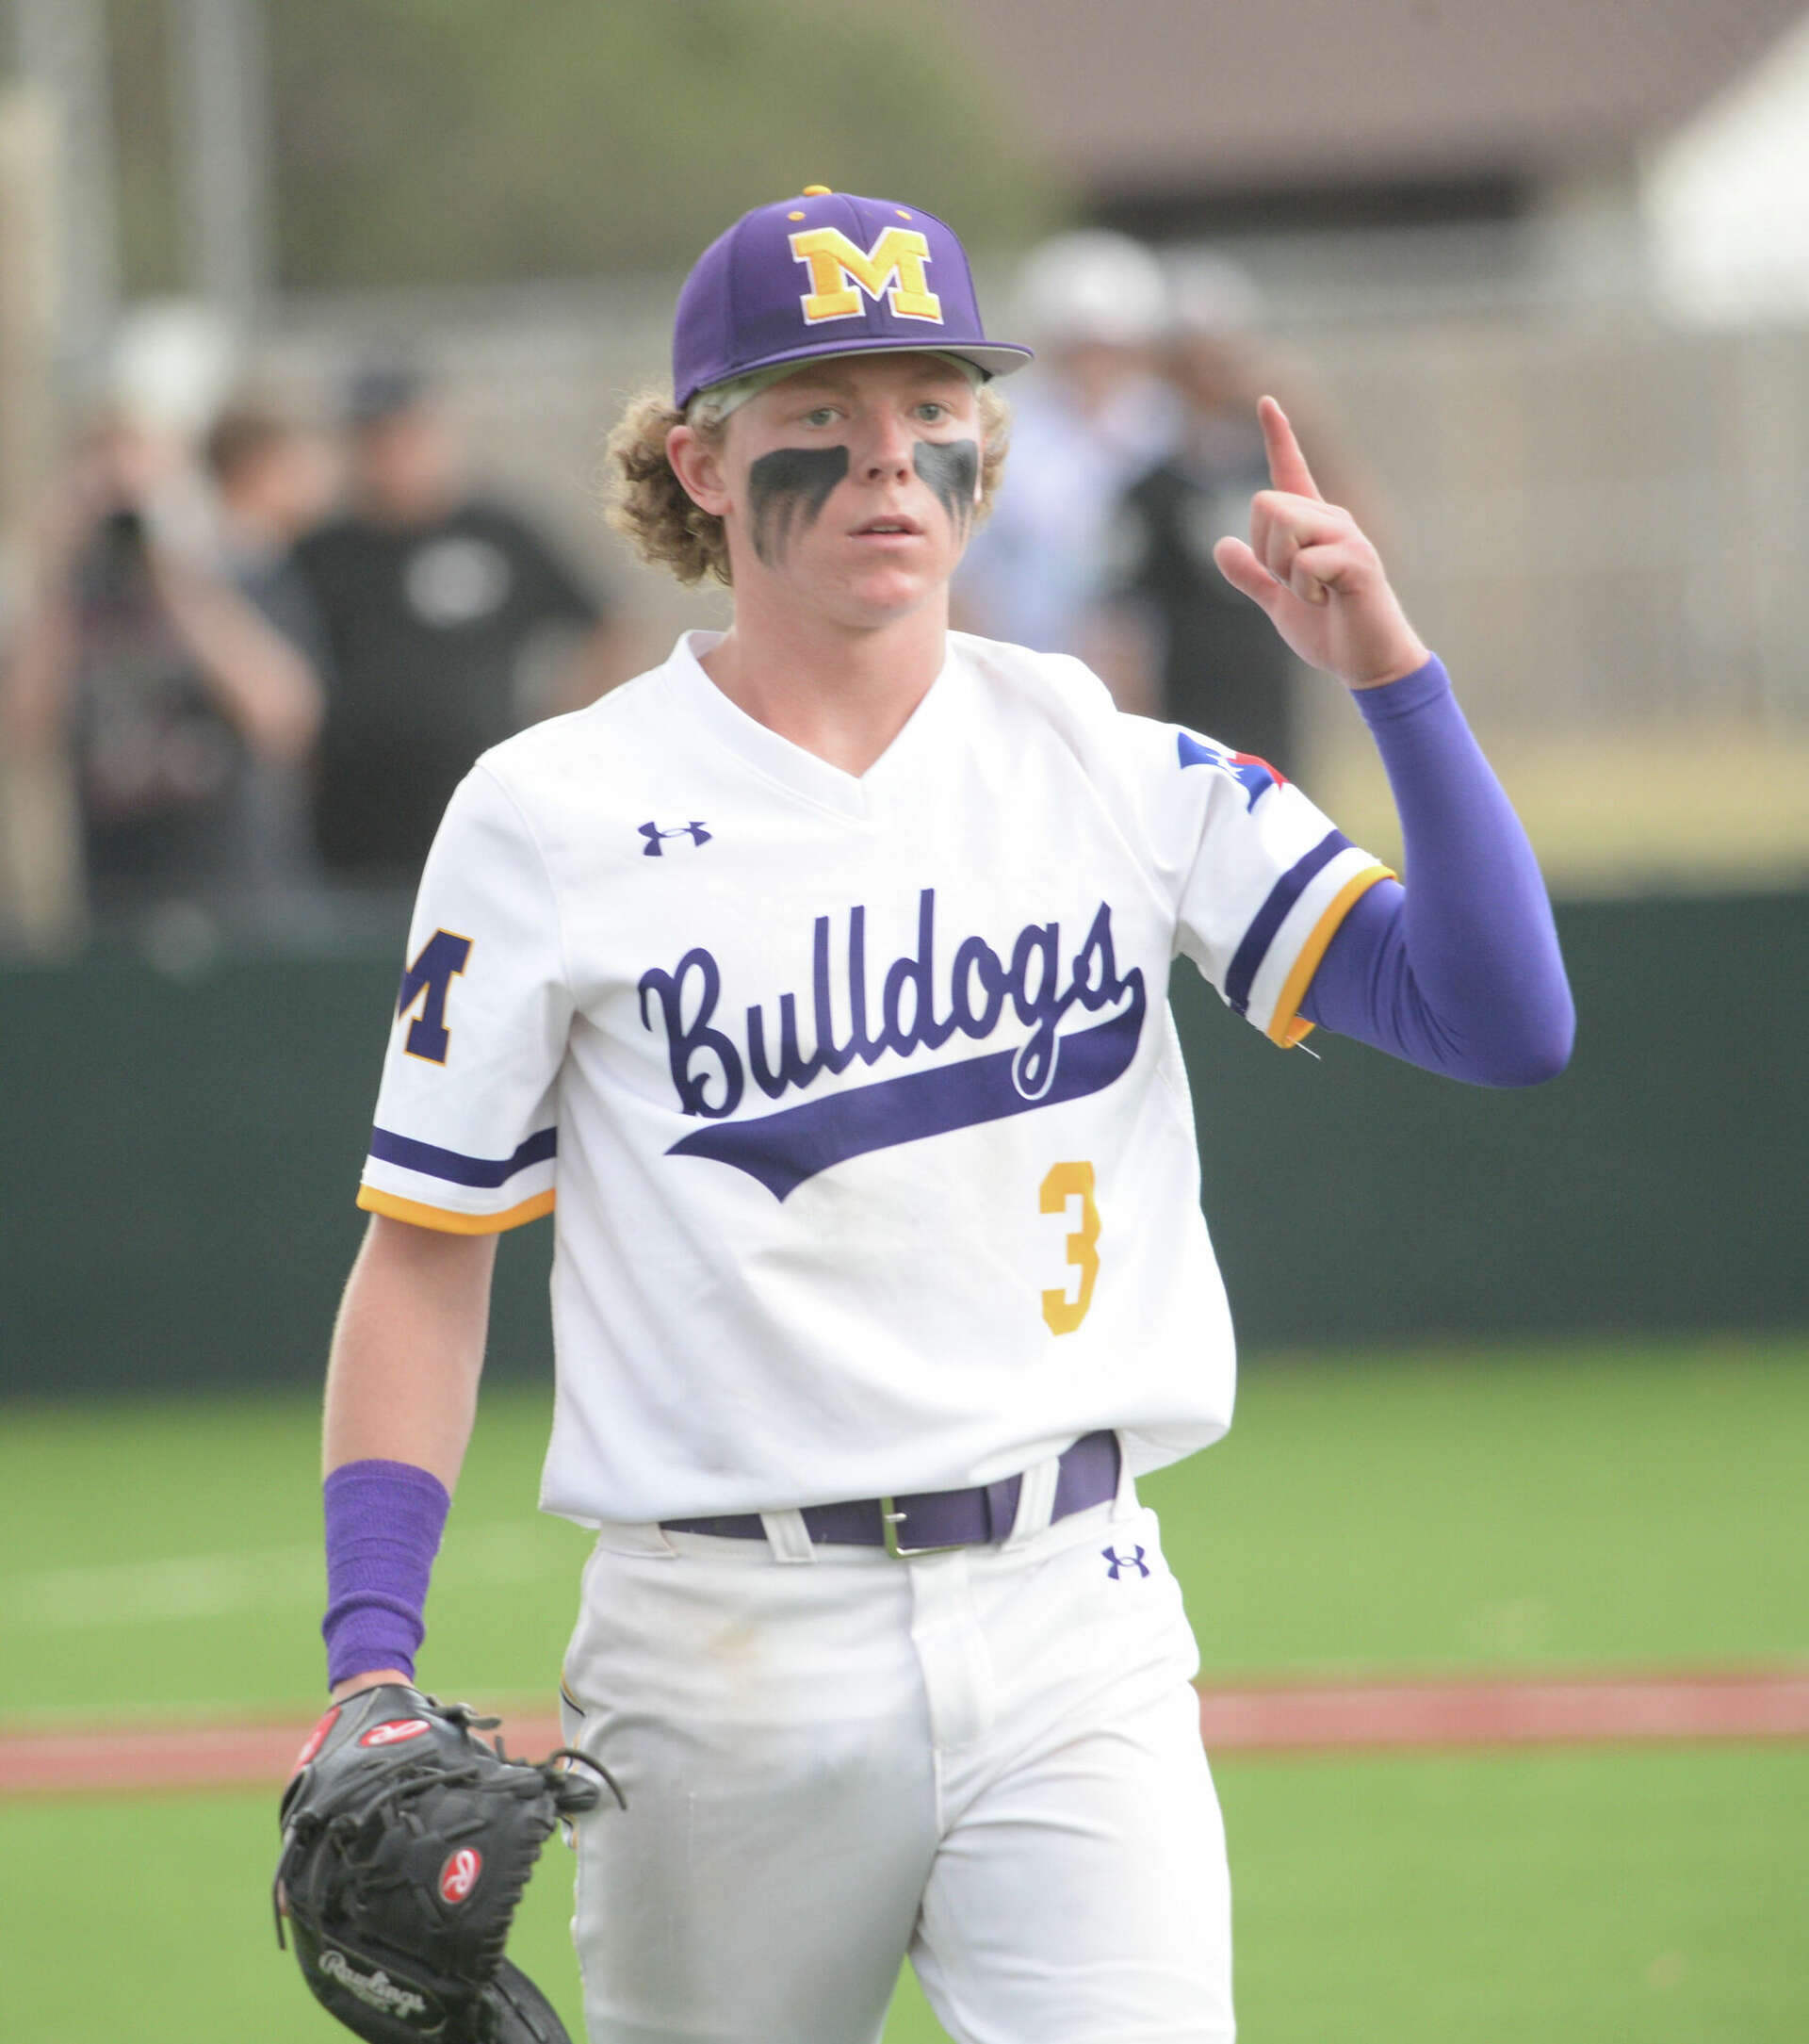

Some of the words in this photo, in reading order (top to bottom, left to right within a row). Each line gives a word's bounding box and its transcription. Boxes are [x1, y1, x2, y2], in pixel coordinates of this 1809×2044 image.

[788, 226, 944, 325] M
[638, 888, 1146, 1119] Bulldogs
[1039, 1160, 1102, 1336] 3
[318, 1950, 427, 2019] Rawlings
